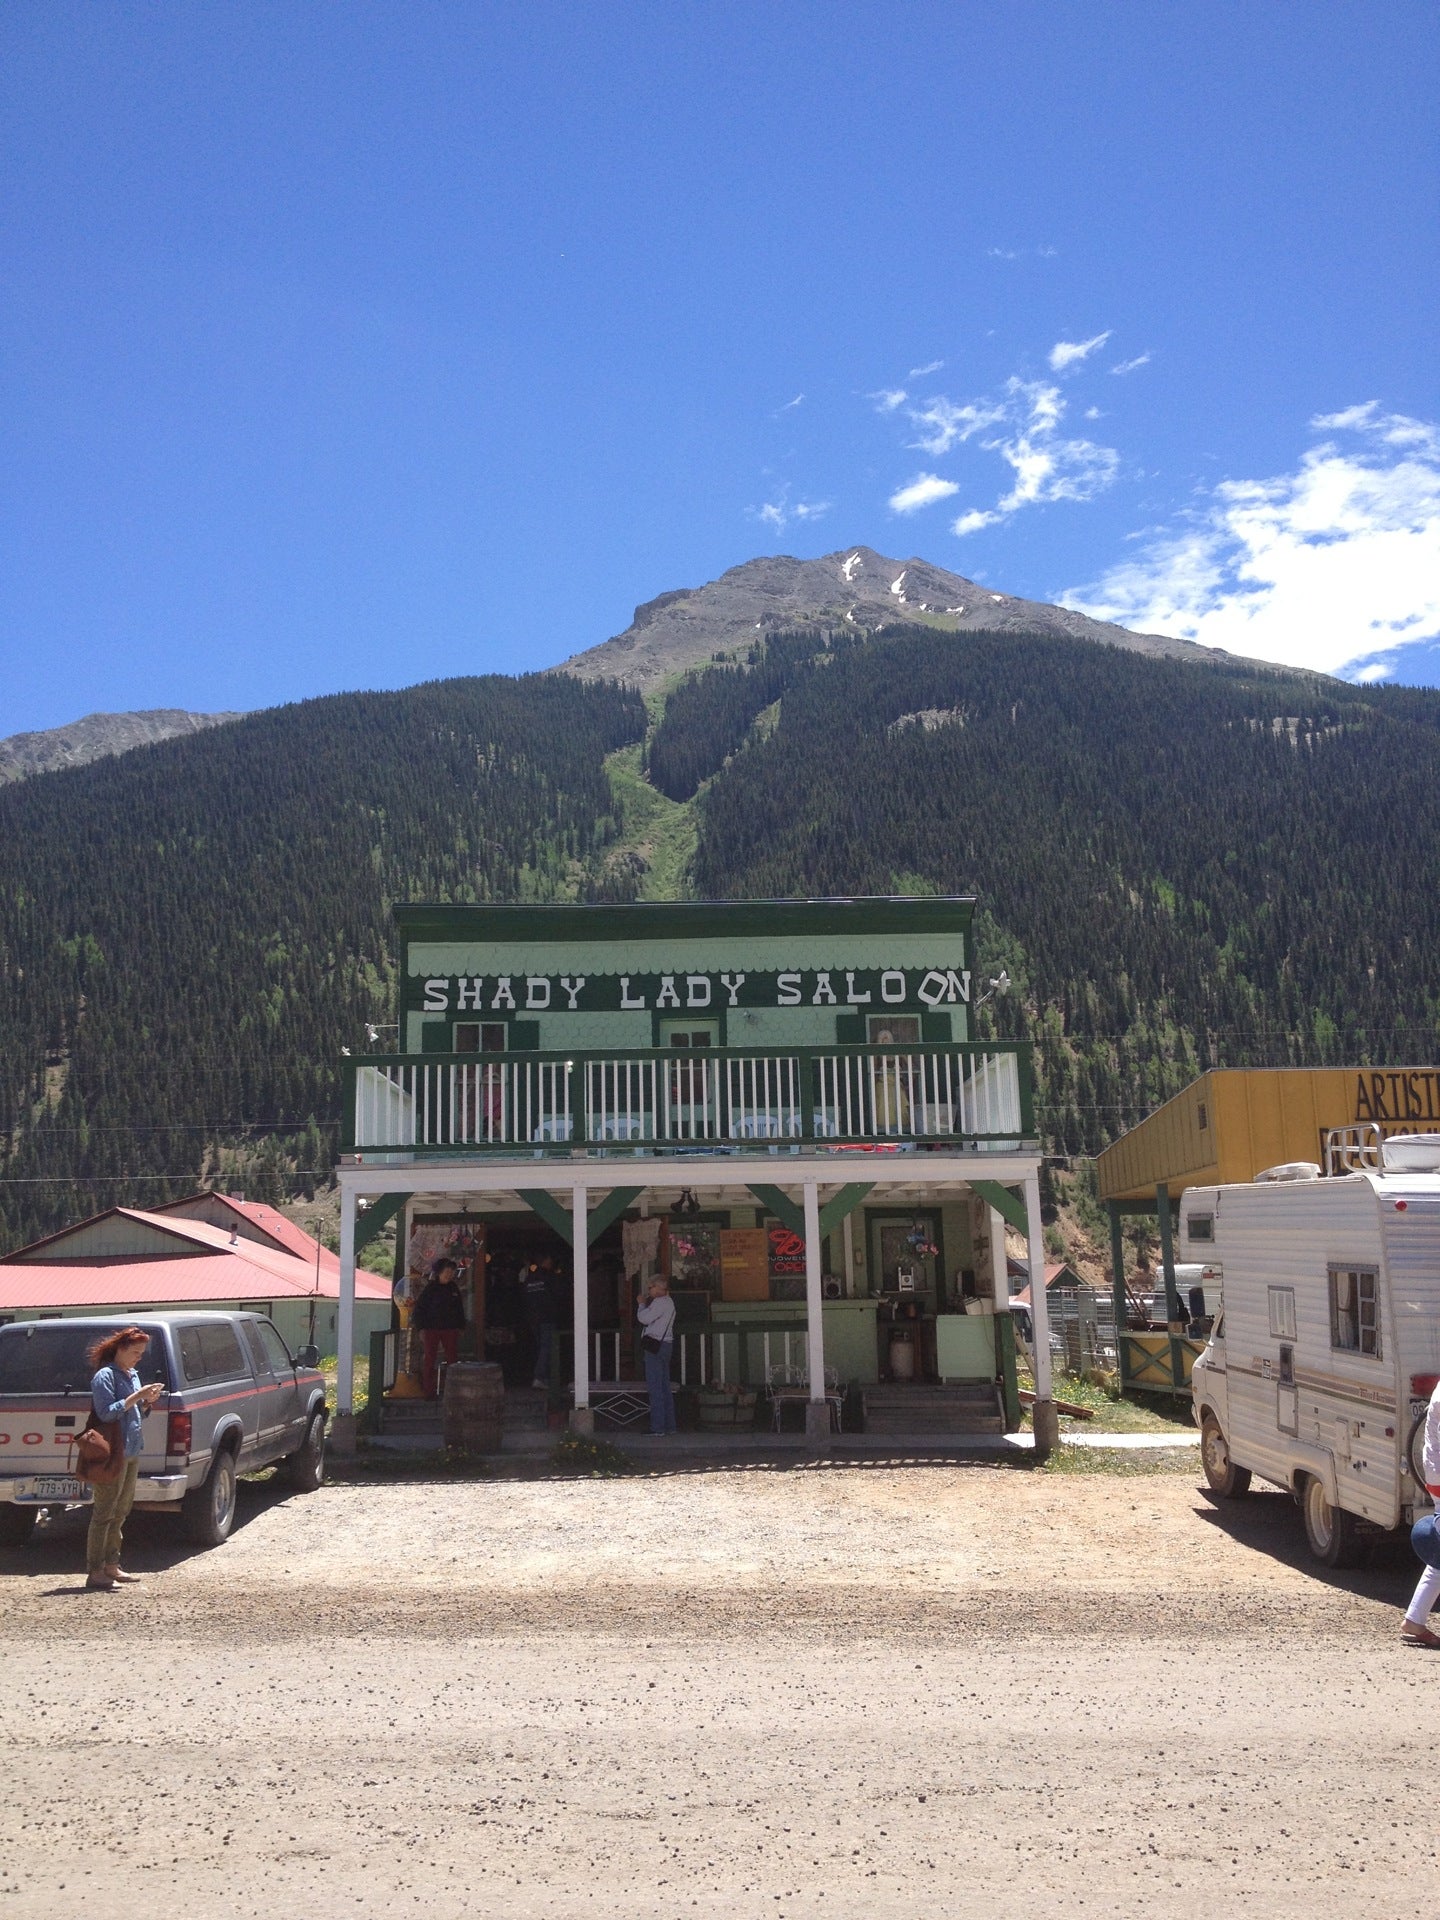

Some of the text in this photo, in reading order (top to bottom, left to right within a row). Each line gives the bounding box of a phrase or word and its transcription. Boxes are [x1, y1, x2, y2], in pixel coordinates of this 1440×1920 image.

[423, 970, 971, 1011] SHADY LADY SALOON
